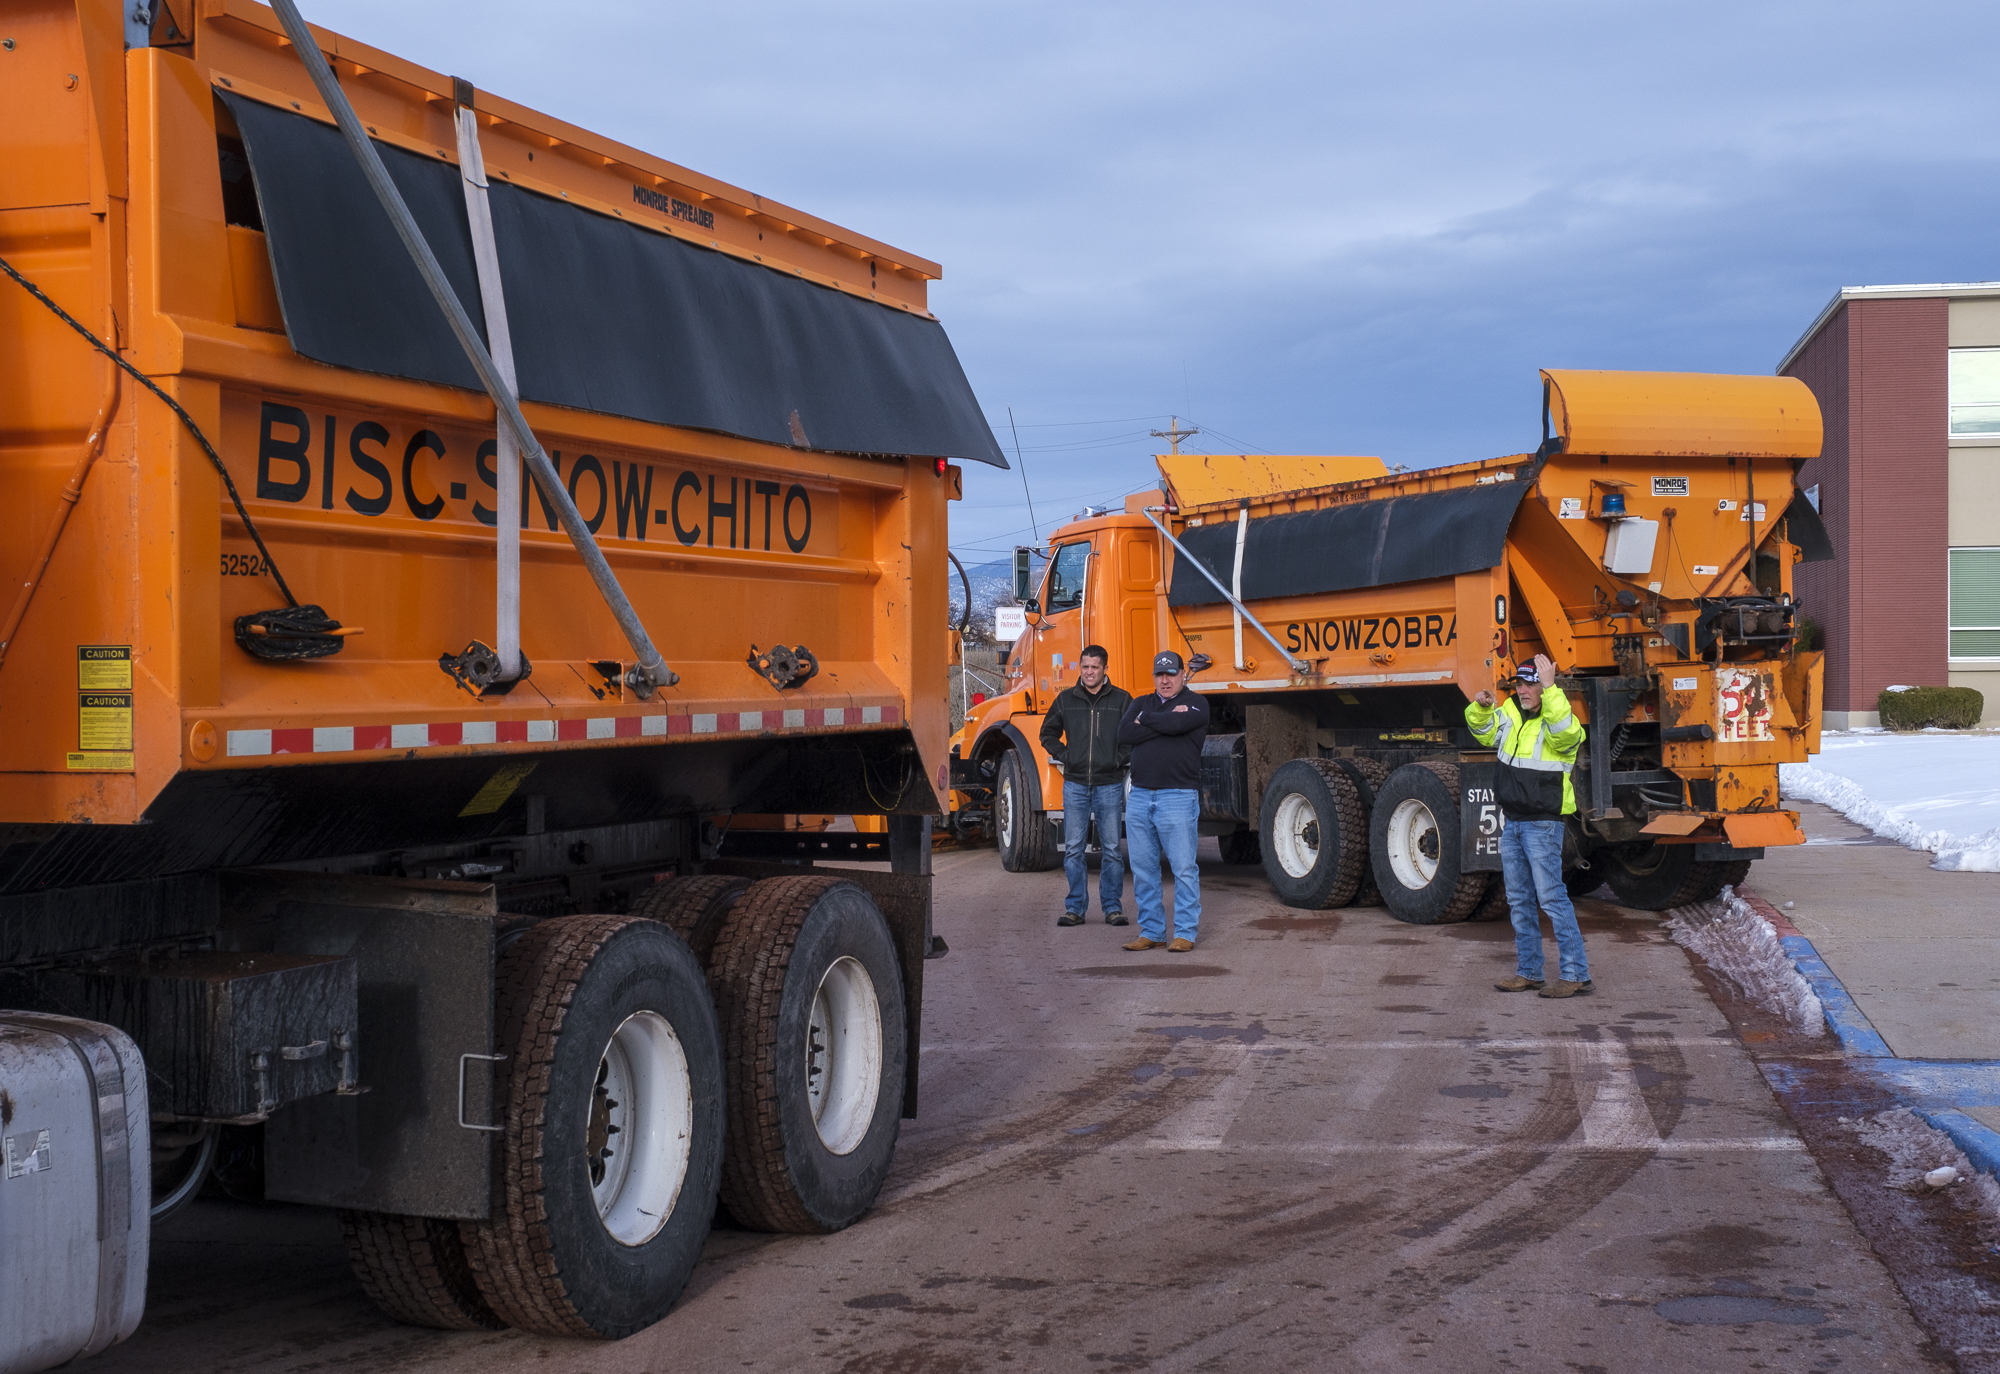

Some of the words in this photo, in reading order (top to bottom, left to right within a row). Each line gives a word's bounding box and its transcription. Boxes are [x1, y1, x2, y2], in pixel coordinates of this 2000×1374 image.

[633, 184, 668, 213] MONROE
[671, 198, 714, 230] SPREADER
[256, 400, 812, 554] BISC-SNOW-CHITO
[1654, 479, 1687, 489] MONROE
[221, 554, 269, 576] 52524
[86, 650, 125, 658] CAUTION
[87, 697, 125, 705] CAUTION
[1724, 720, 1769, 738] FEET
[1468, 788, 1495, 802] STAY
